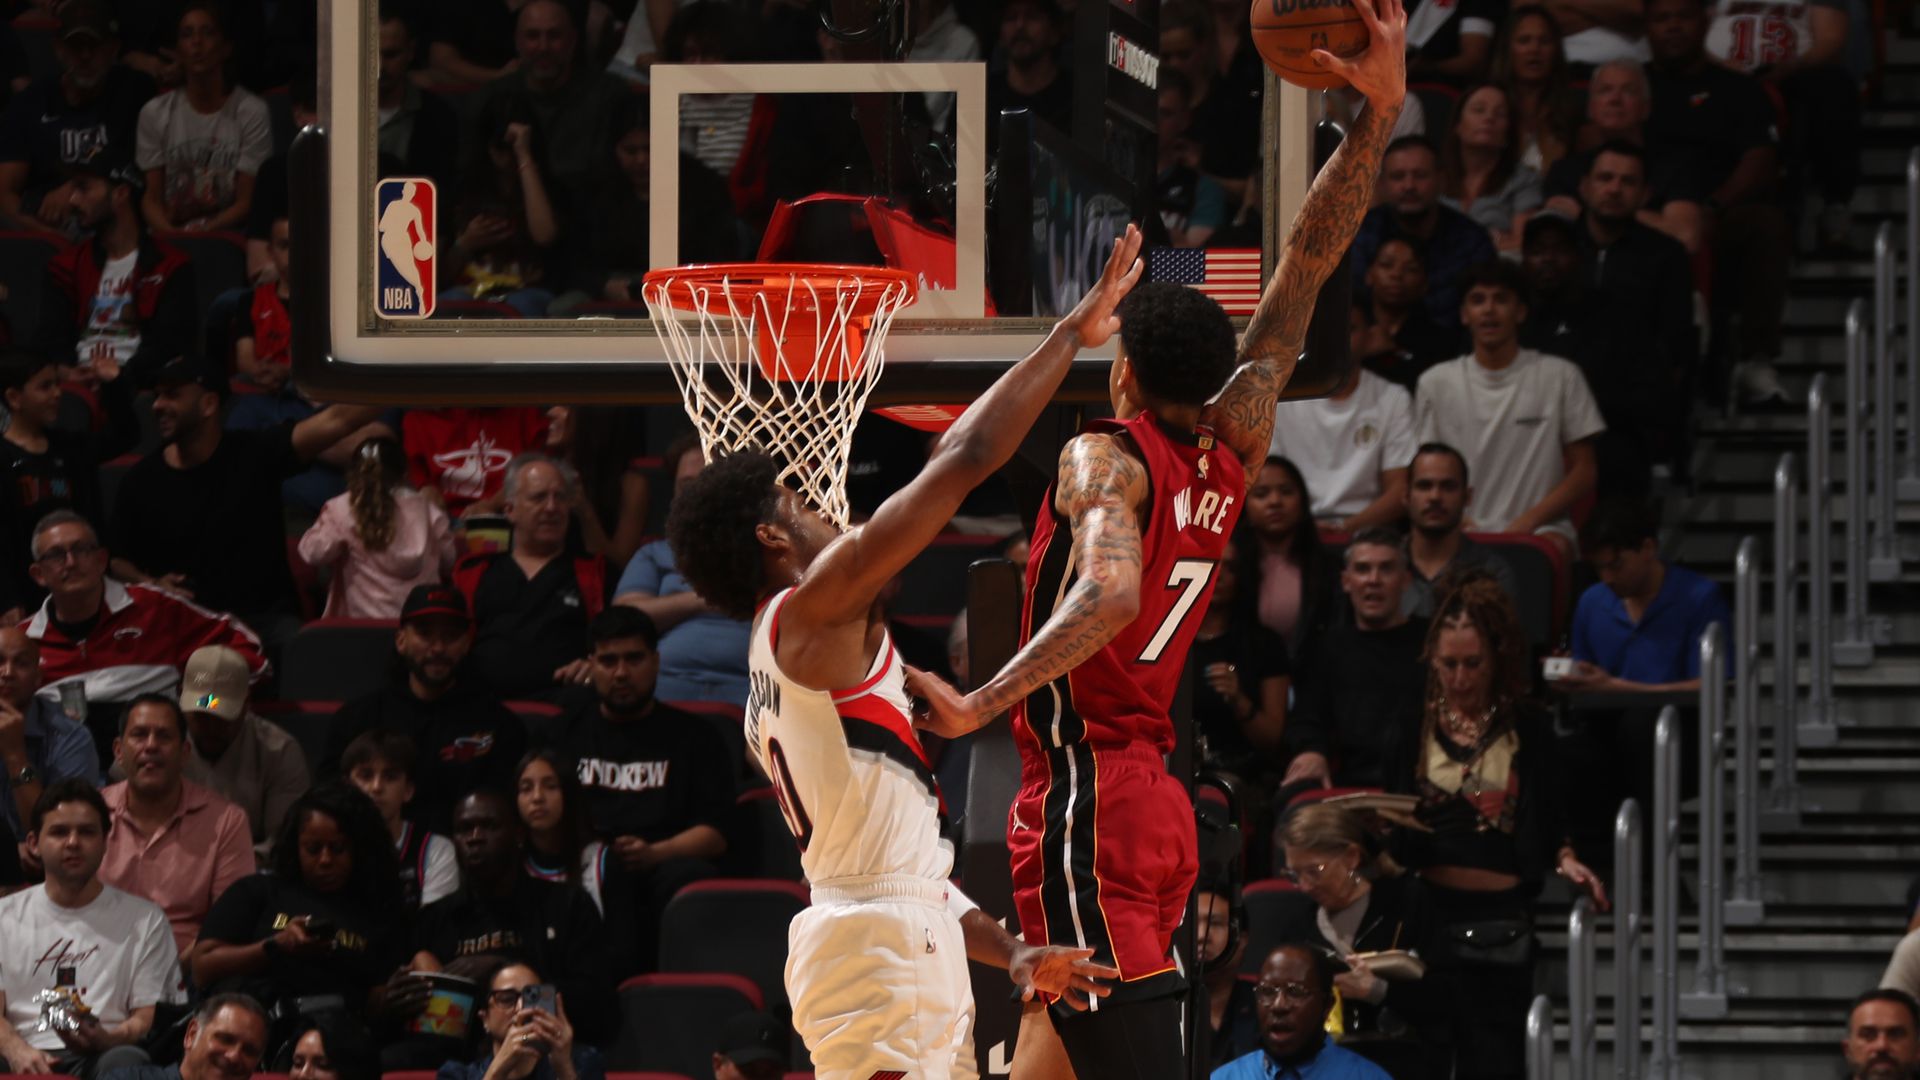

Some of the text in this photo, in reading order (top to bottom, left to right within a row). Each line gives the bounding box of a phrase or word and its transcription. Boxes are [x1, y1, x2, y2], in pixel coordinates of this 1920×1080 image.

[1731, 18, 1797, 66] 13
[384, 287, 413, 310] NBA
[1173, 486, 1235, 535] WARE
[1137, 558, 1217, 664] 7
